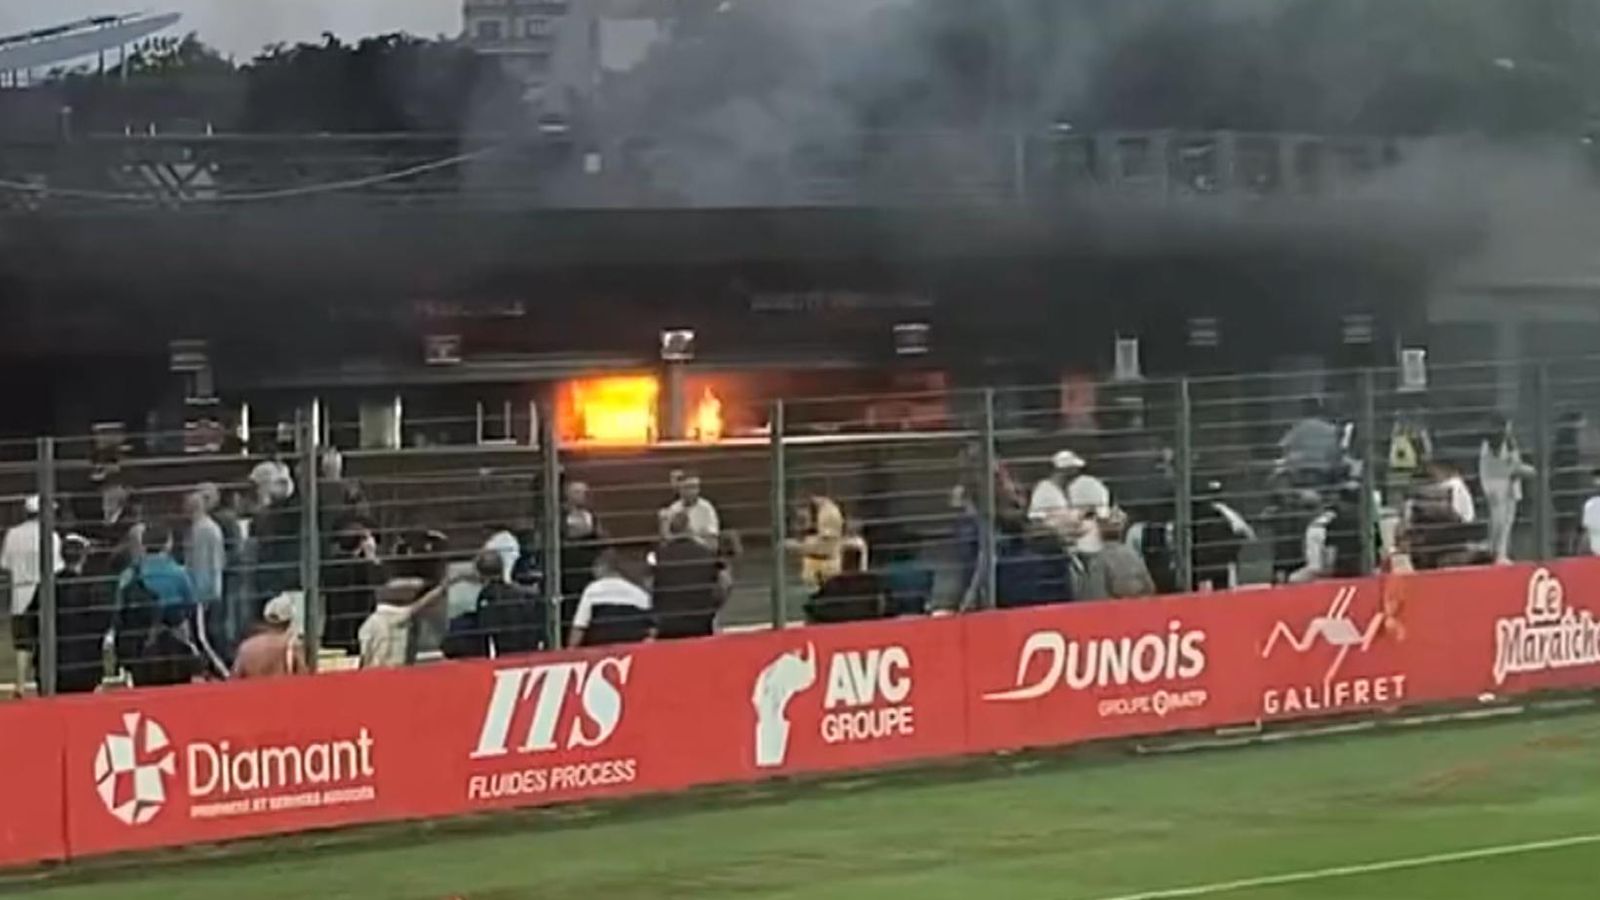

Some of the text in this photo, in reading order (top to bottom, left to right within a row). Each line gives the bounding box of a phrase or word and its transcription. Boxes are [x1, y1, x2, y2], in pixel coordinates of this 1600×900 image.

[1526, 568, 1563, 622] Le
[824, 646, 911, 708] AVC
[1264, 675, 1406, 714] GALIFRET
[469, 655, 632, 759] ITS
[821, 706, 914, 742] GROUPE
[187, 727, 374, 796] Diamant
[469, 759, 636, 799] FLUIDES PROCESS
